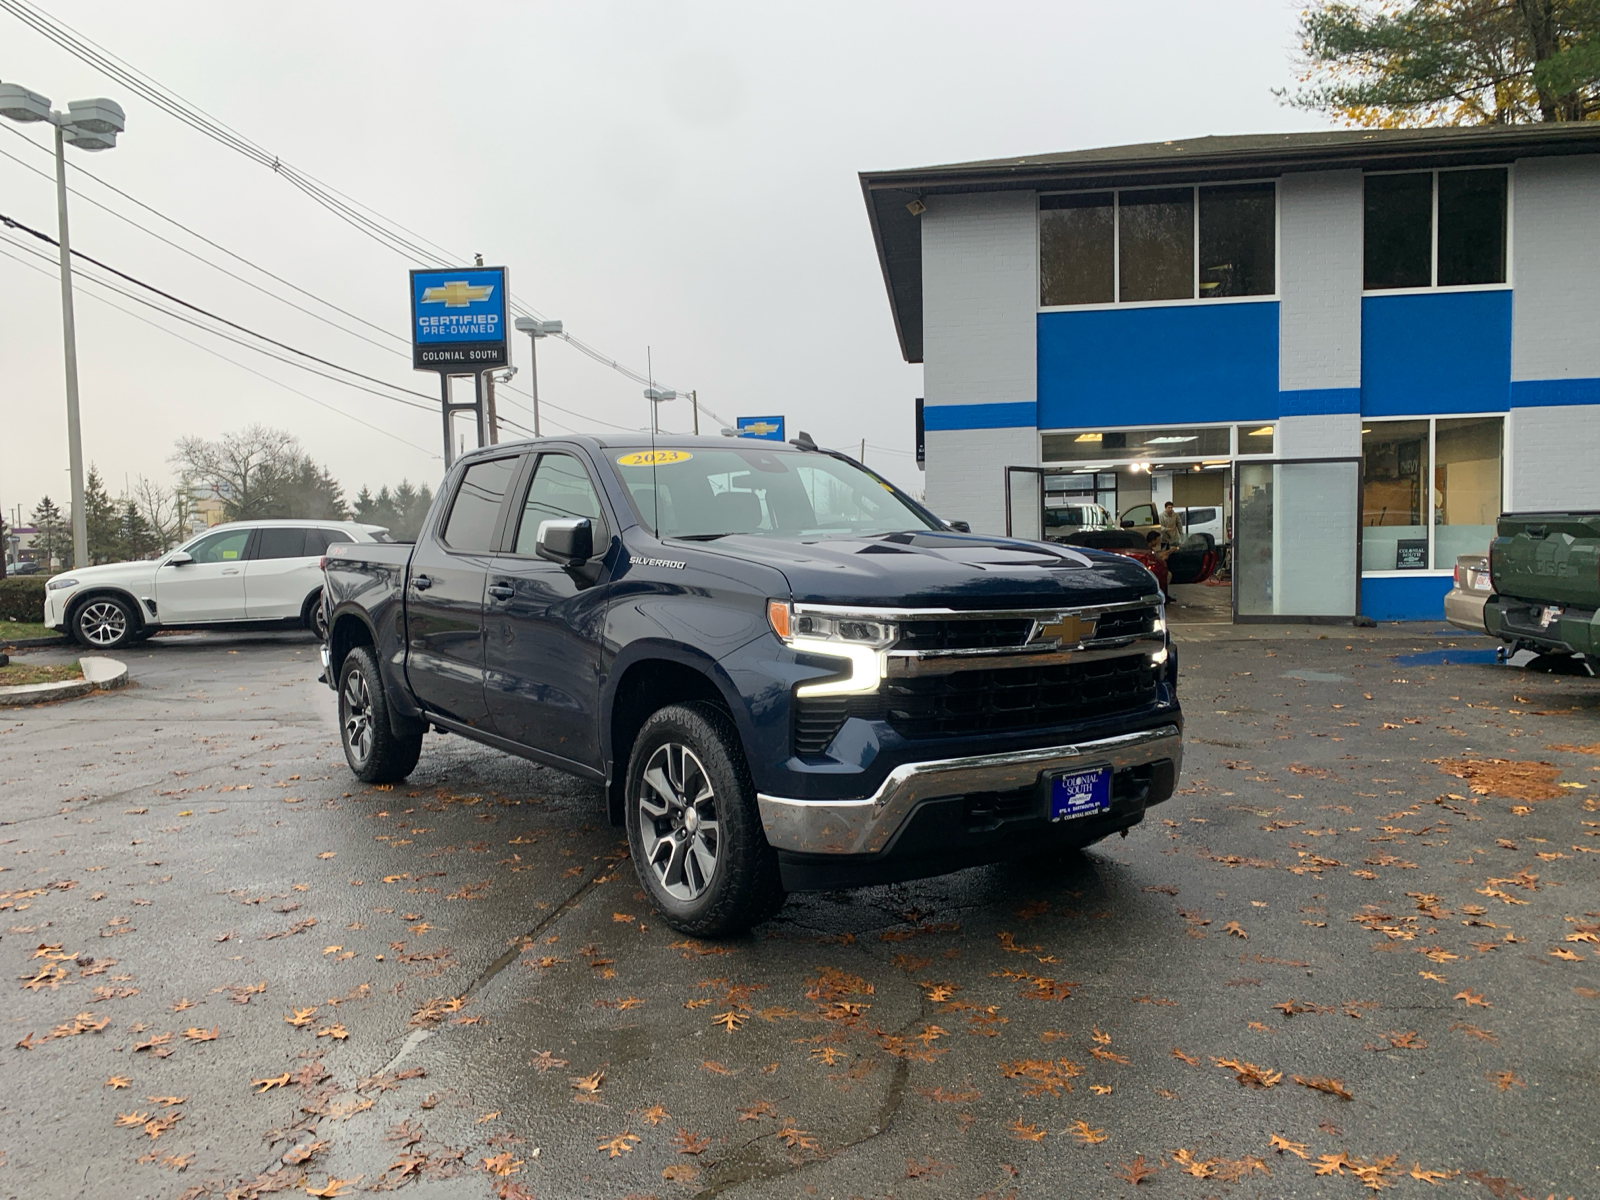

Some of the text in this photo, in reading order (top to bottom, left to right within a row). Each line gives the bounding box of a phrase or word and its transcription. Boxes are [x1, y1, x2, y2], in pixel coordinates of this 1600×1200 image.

[419, 314, 498, 325] CERTIFIED
[423, 324, 495, 335] PRE-OWNED
[422, 350, 498, 361] COLONIAL SOUTH
[633, 451, 678, 464] 2023
[629, 556, 685, 569] SILVERADO
[1062, 774, 1098, 787] COLONIAL
[1067, 783, 1092, 795] SOUTH
